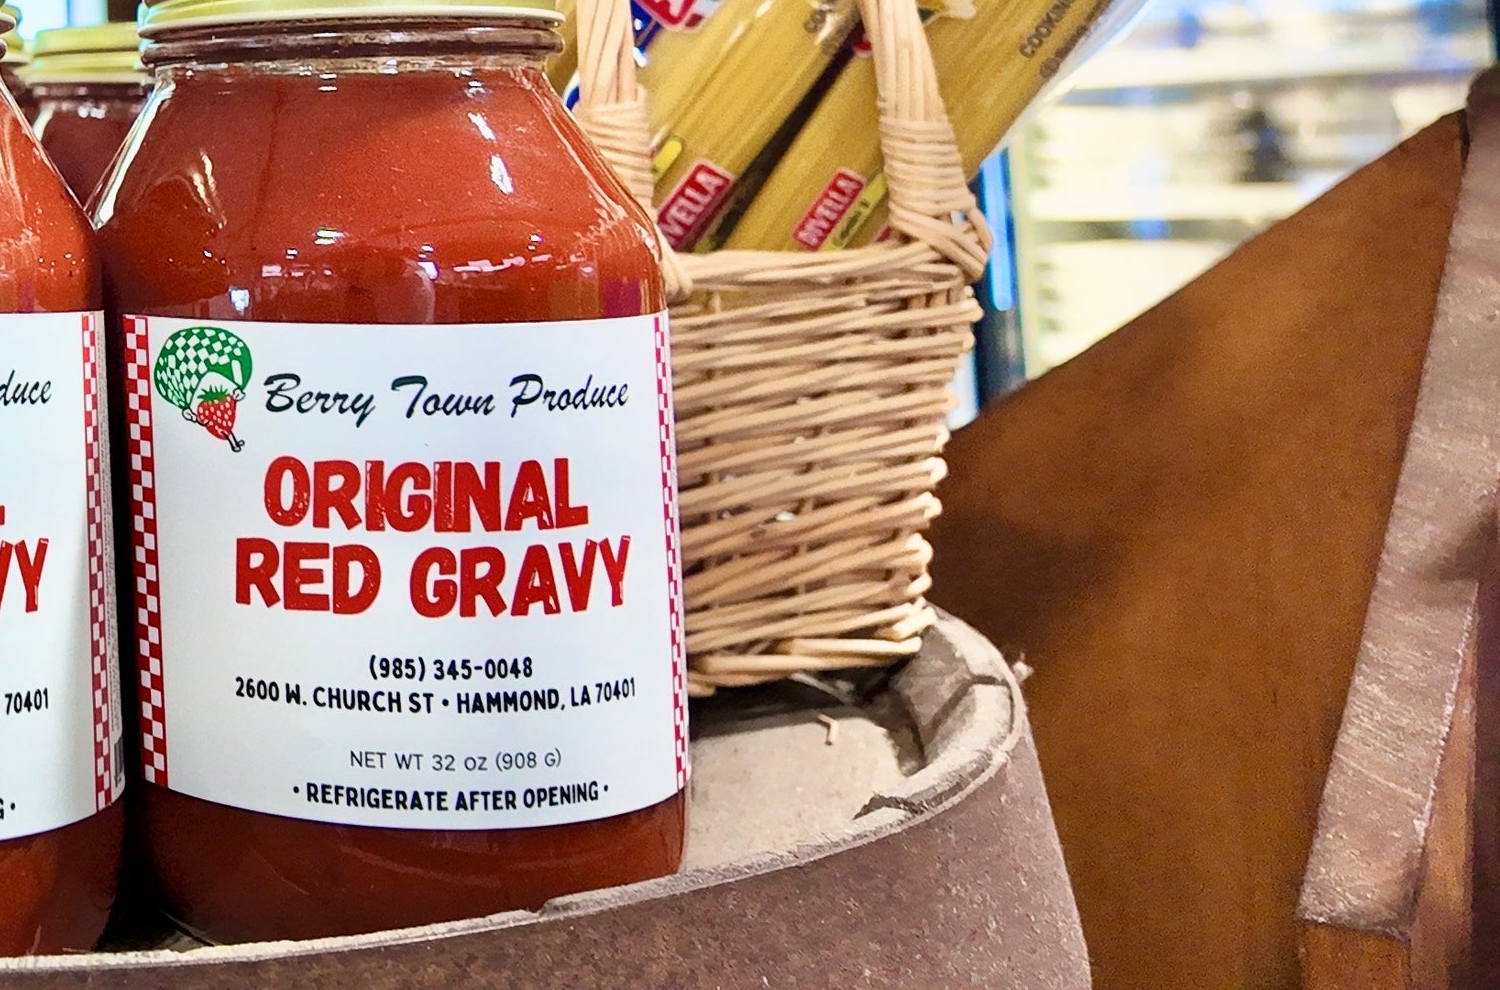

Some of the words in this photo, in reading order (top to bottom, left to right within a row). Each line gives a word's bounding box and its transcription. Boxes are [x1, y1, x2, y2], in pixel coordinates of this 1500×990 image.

[262, 372, 377, 428] Berry
[390, 374, 496, 419] Town
[508, 372, 630, 419] Produce
[263, 455, 590, 533] ORIGINAL
[235, 536, 382, 615] RED
[409, 534, 631, 618] GRAVY
[368, 655, 426, 682] (985)
[433, 656, 533, 680] 345-0048
[4, 688, 50, 716] 70401
[235, 677, 280, 703] 2600
[285, 684, 307, 707] W.
[312, 686, 402, 713] CHURCH
[409, 692, 435, 714] ST
[456, 688, 566, 714] HAMMOND,
[570, 683, 591, 707] LA
[595, 677, 636, 704] 70401
[350, 750, 387, 770] NET
[395, 752, 424, 772] WT
[431, 754, 456, 772] 32
[495, 751, 537, 772] (908
[306, 782, 449, 812] REFRIGERATE
[454, 788, 517, 812] AFTER
[523, 781, 600, 810] OPENING
